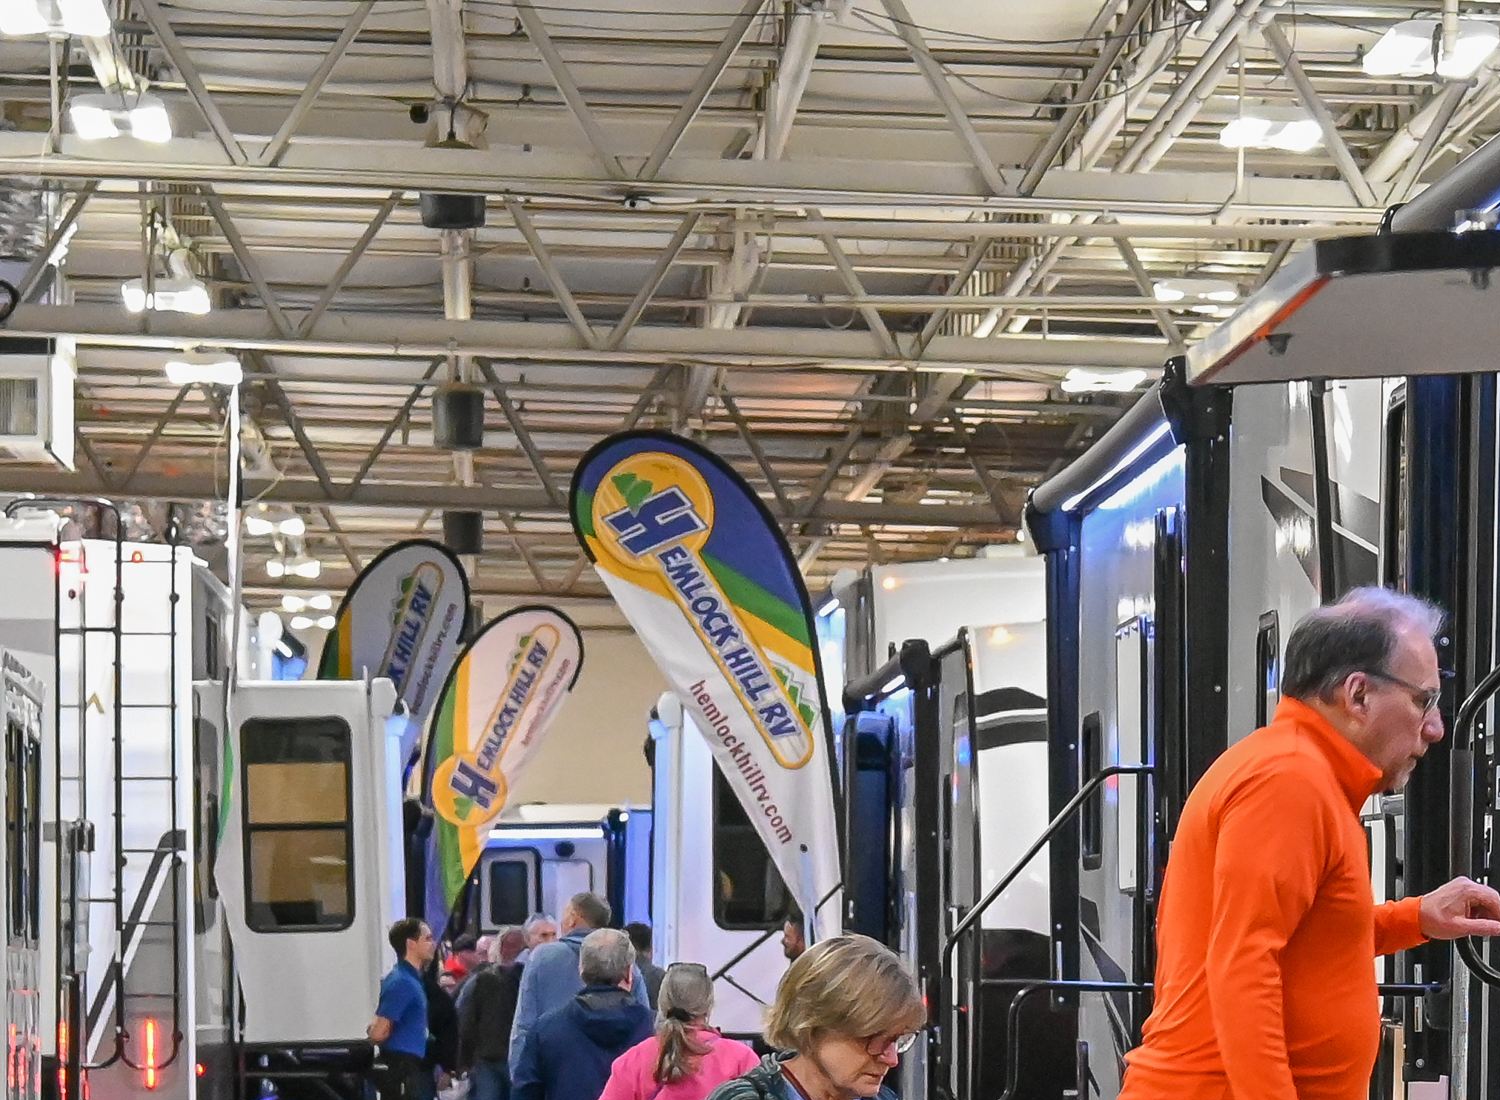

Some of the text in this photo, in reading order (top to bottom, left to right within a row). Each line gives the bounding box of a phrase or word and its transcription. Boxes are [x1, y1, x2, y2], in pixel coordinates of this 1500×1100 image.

[394, 619, 421, 664] HILL
[409, 583, 433, 618] RV
[509, 668, 536, 705] HILL
[527, 640, 549, 670] RV
[723, 647, 770, 702] HILL
[758, 702, 798, 737] RV
[690, 680, 793, 845] hemlockhillrv.com
